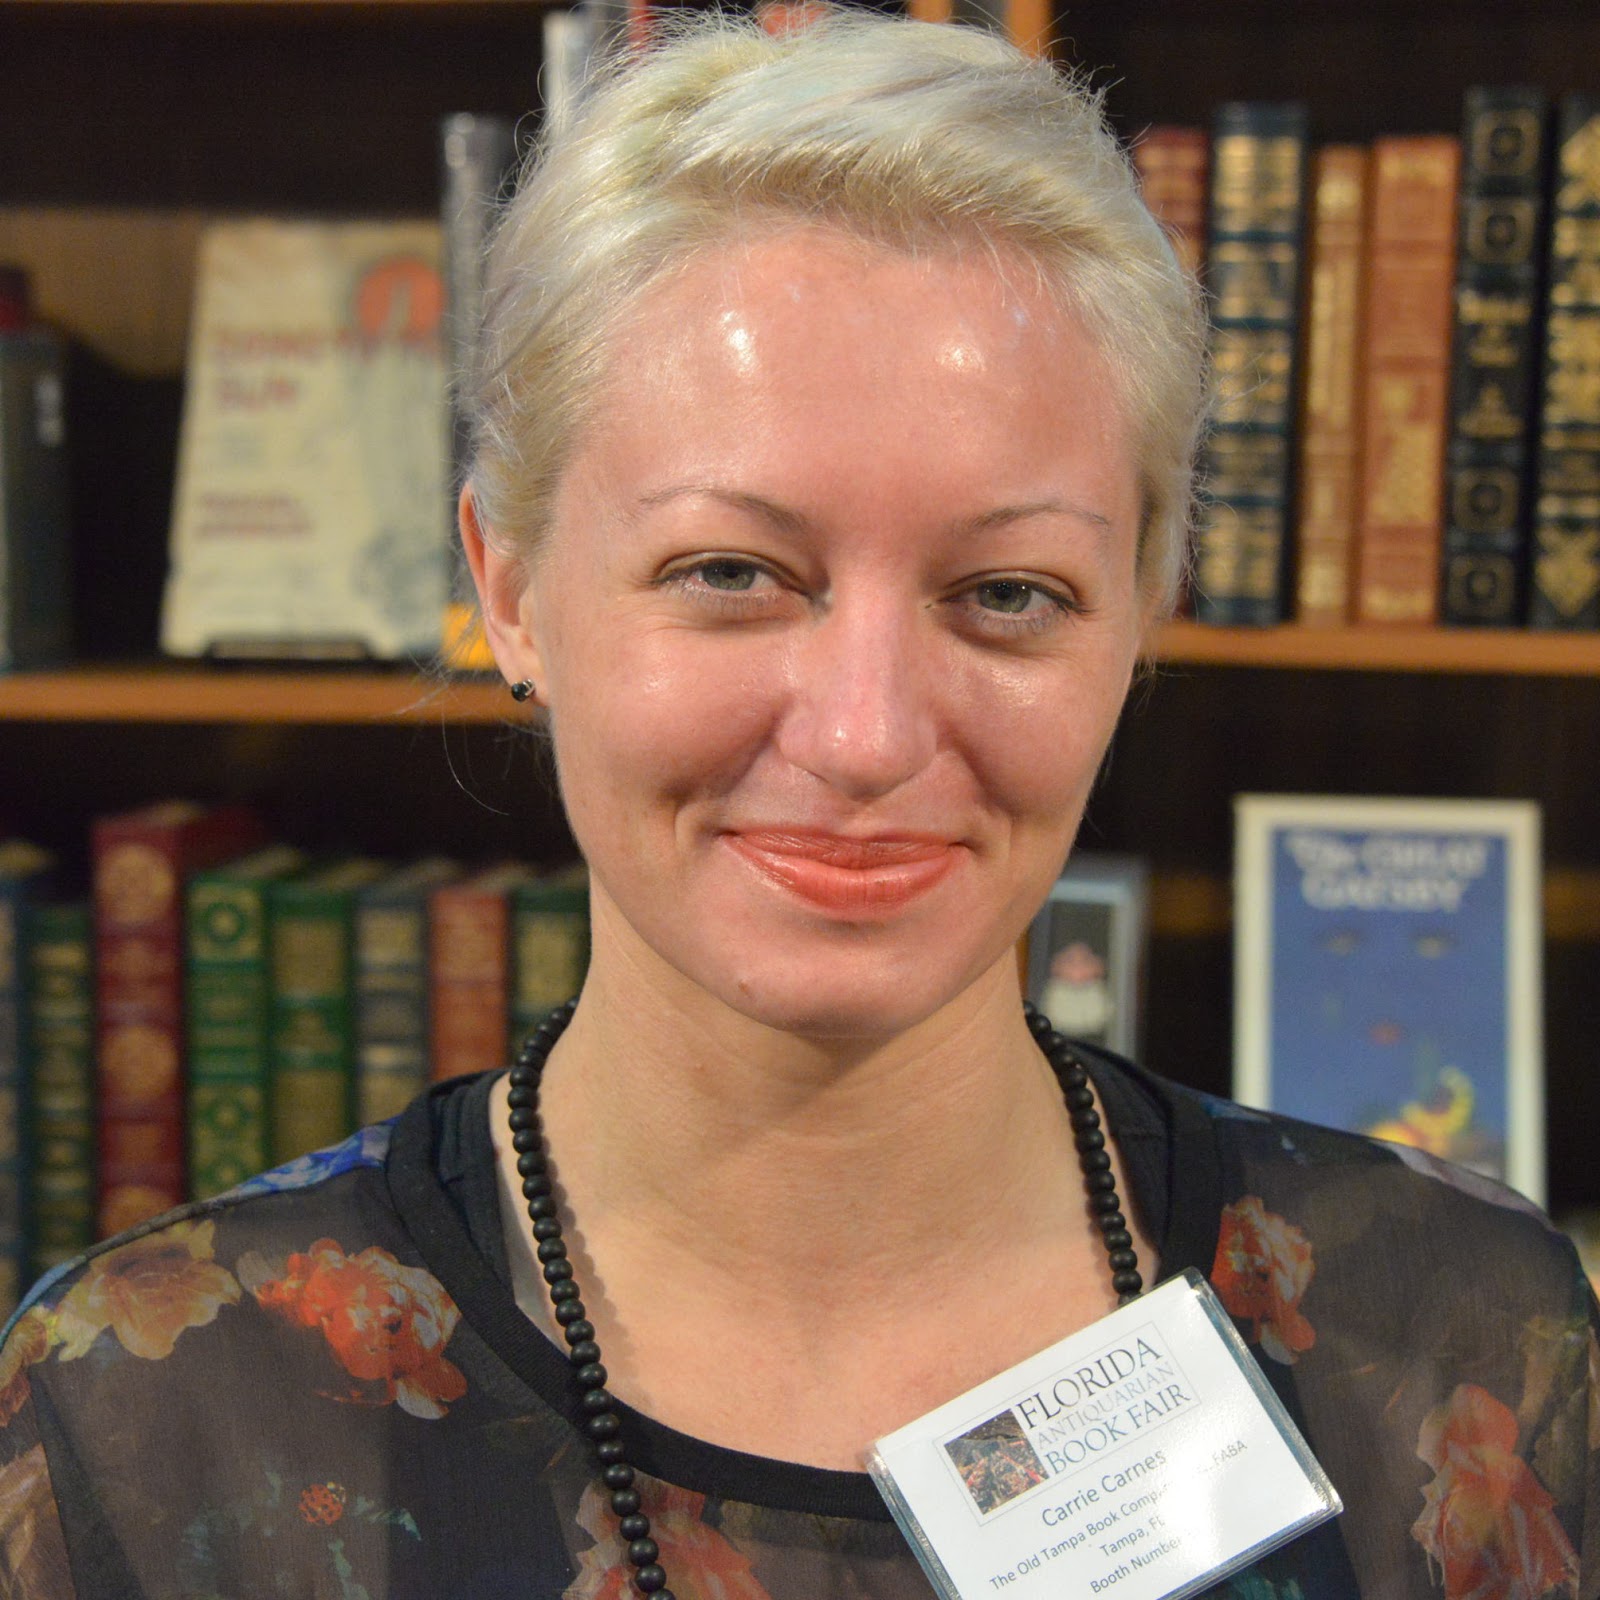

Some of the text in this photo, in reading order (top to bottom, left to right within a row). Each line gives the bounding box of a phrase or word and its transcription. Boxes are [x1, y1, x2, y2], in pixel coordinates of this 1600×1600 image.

[1015, 1337, 1162, 1430] FLORIDA
[1036, 1361, 1176, 1450] ANTIQUARIAN
[1044, 1384, 1191, 1475] BOOK FAIR
[1041, 1450, 1167, 1527] Carrie Carnes
[989, 1568, 1017, 1591] The
[1017, 1552, 1041, 1575] Old
[1040, 1531, 1087, 1562] Tampa
[1086, 1510, 1121, 1537] Book
[1089, 1564, 1131, 1595] Booth
[1099, 1526, 1150, 1558] Tampa,
